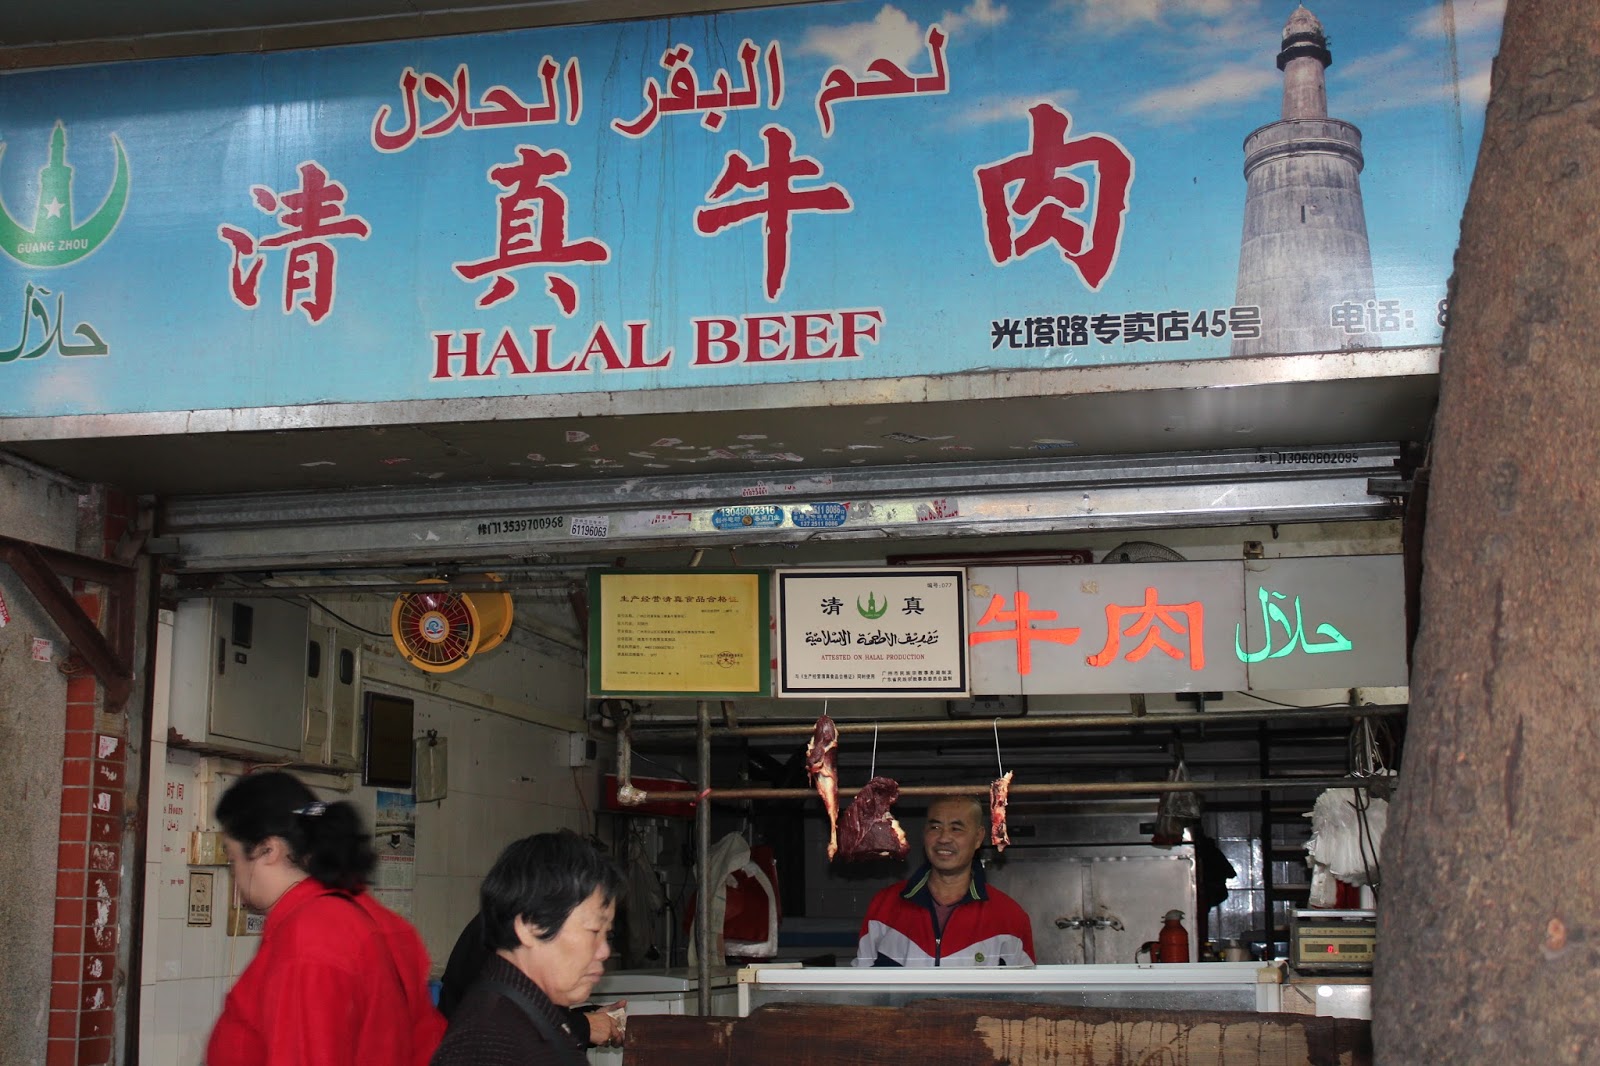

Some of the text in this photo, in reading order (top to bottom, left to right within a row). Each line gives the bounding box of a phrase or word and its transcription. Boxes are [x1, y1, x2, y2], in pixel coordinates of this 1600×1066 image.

[374, 27, 947, 151] لحم البقر الحلال
[218, 104, 1132, 322] 清真牛肉
[17, 239, 89, 254] GUANG ZHOU
[432, 311, 882, 378] HALAL BEEF
[991, 305, 1260, 348] 光塔路专卖店45号
[572, 524, 607, 537] 61196063
[821, 597, 925, 616] 清 真
[969, 587, 1205, 675] 牛肉
[168, 804, 183, 815] Hours
